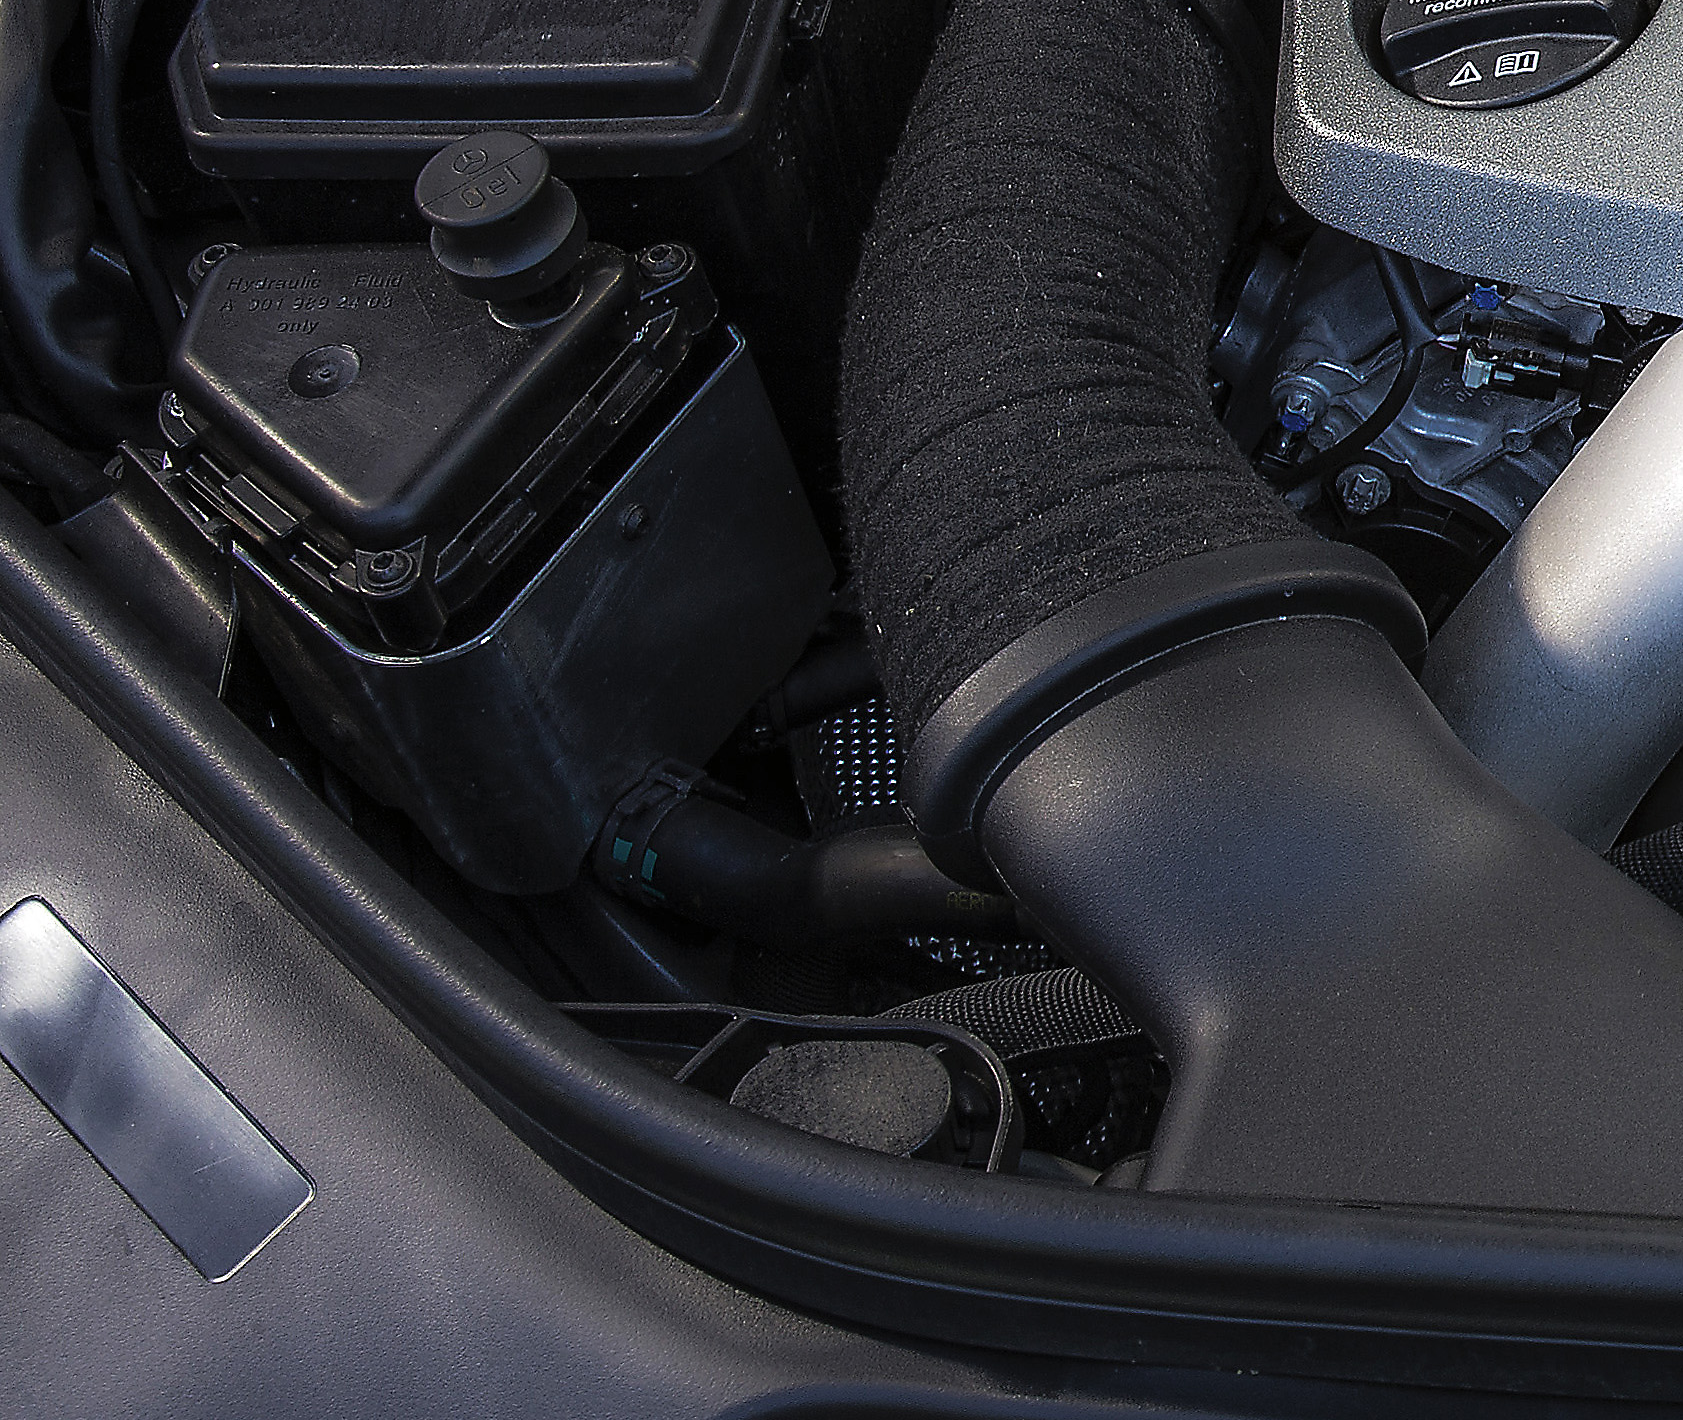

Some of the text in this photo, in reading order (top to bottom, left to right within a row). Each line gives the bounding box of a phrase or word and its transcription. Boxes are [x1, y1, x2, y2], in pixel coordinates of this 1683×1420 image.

[226, 274, 403, 292] Hydraulic Fluid
[219, 300, 234, 312] A
[277, 319, 320, 334] only
